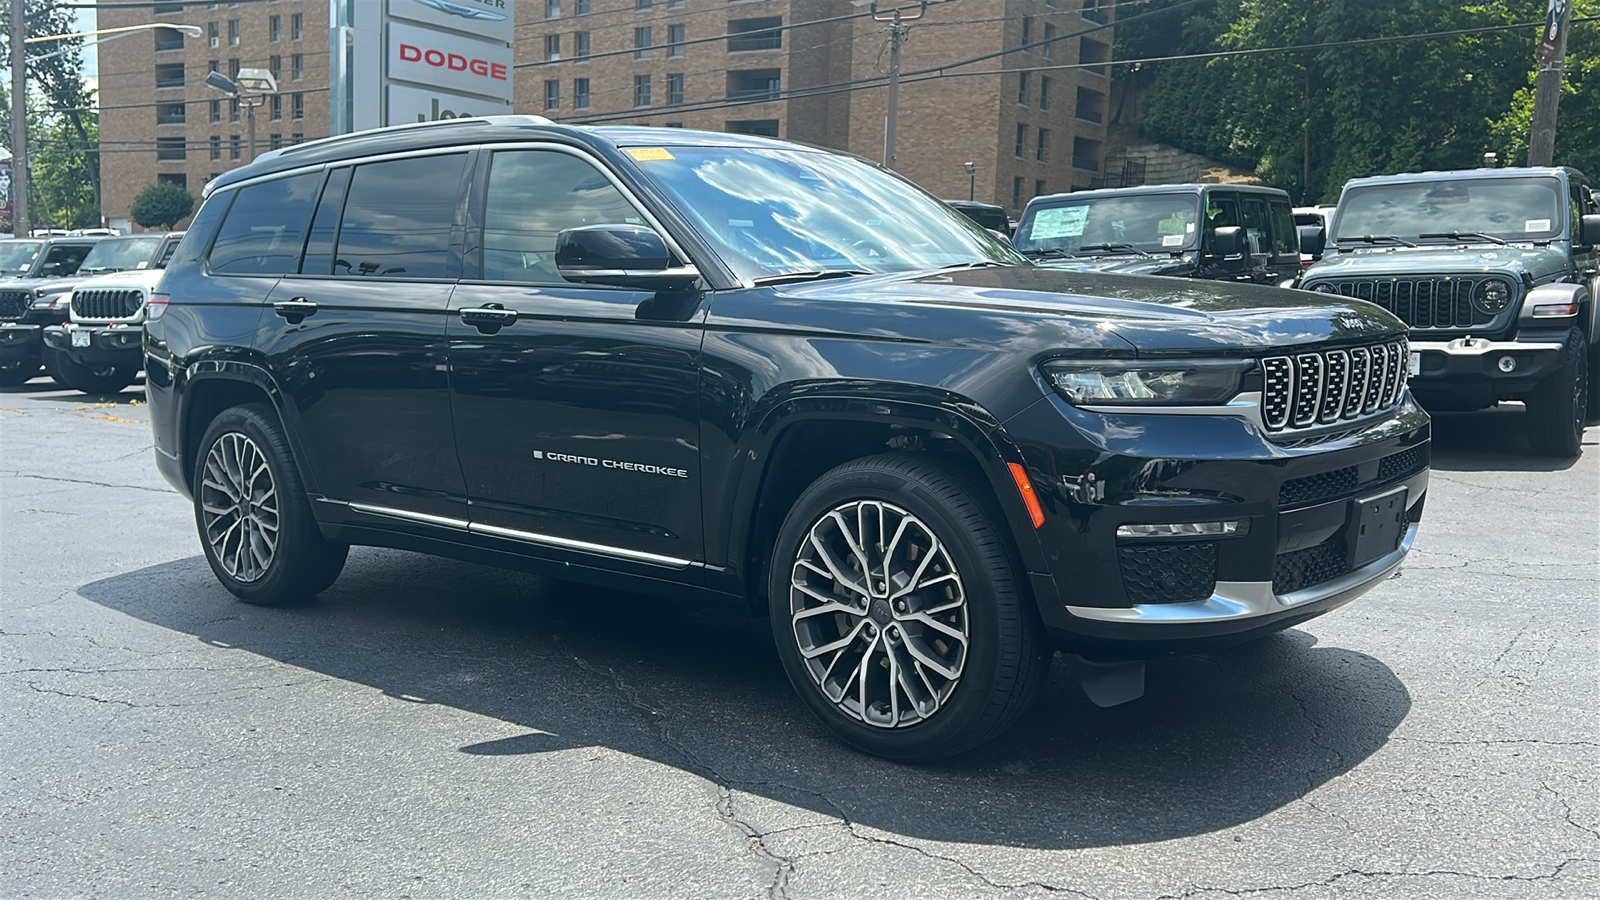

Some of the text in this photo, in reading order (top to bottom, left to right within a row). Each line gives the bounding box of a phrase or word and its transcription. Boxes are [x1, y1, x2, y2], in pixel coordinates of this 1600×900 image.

[400, 43, 507, 80] DODGE
[546, 452, 688, 478] GRAND CHEROKEE
